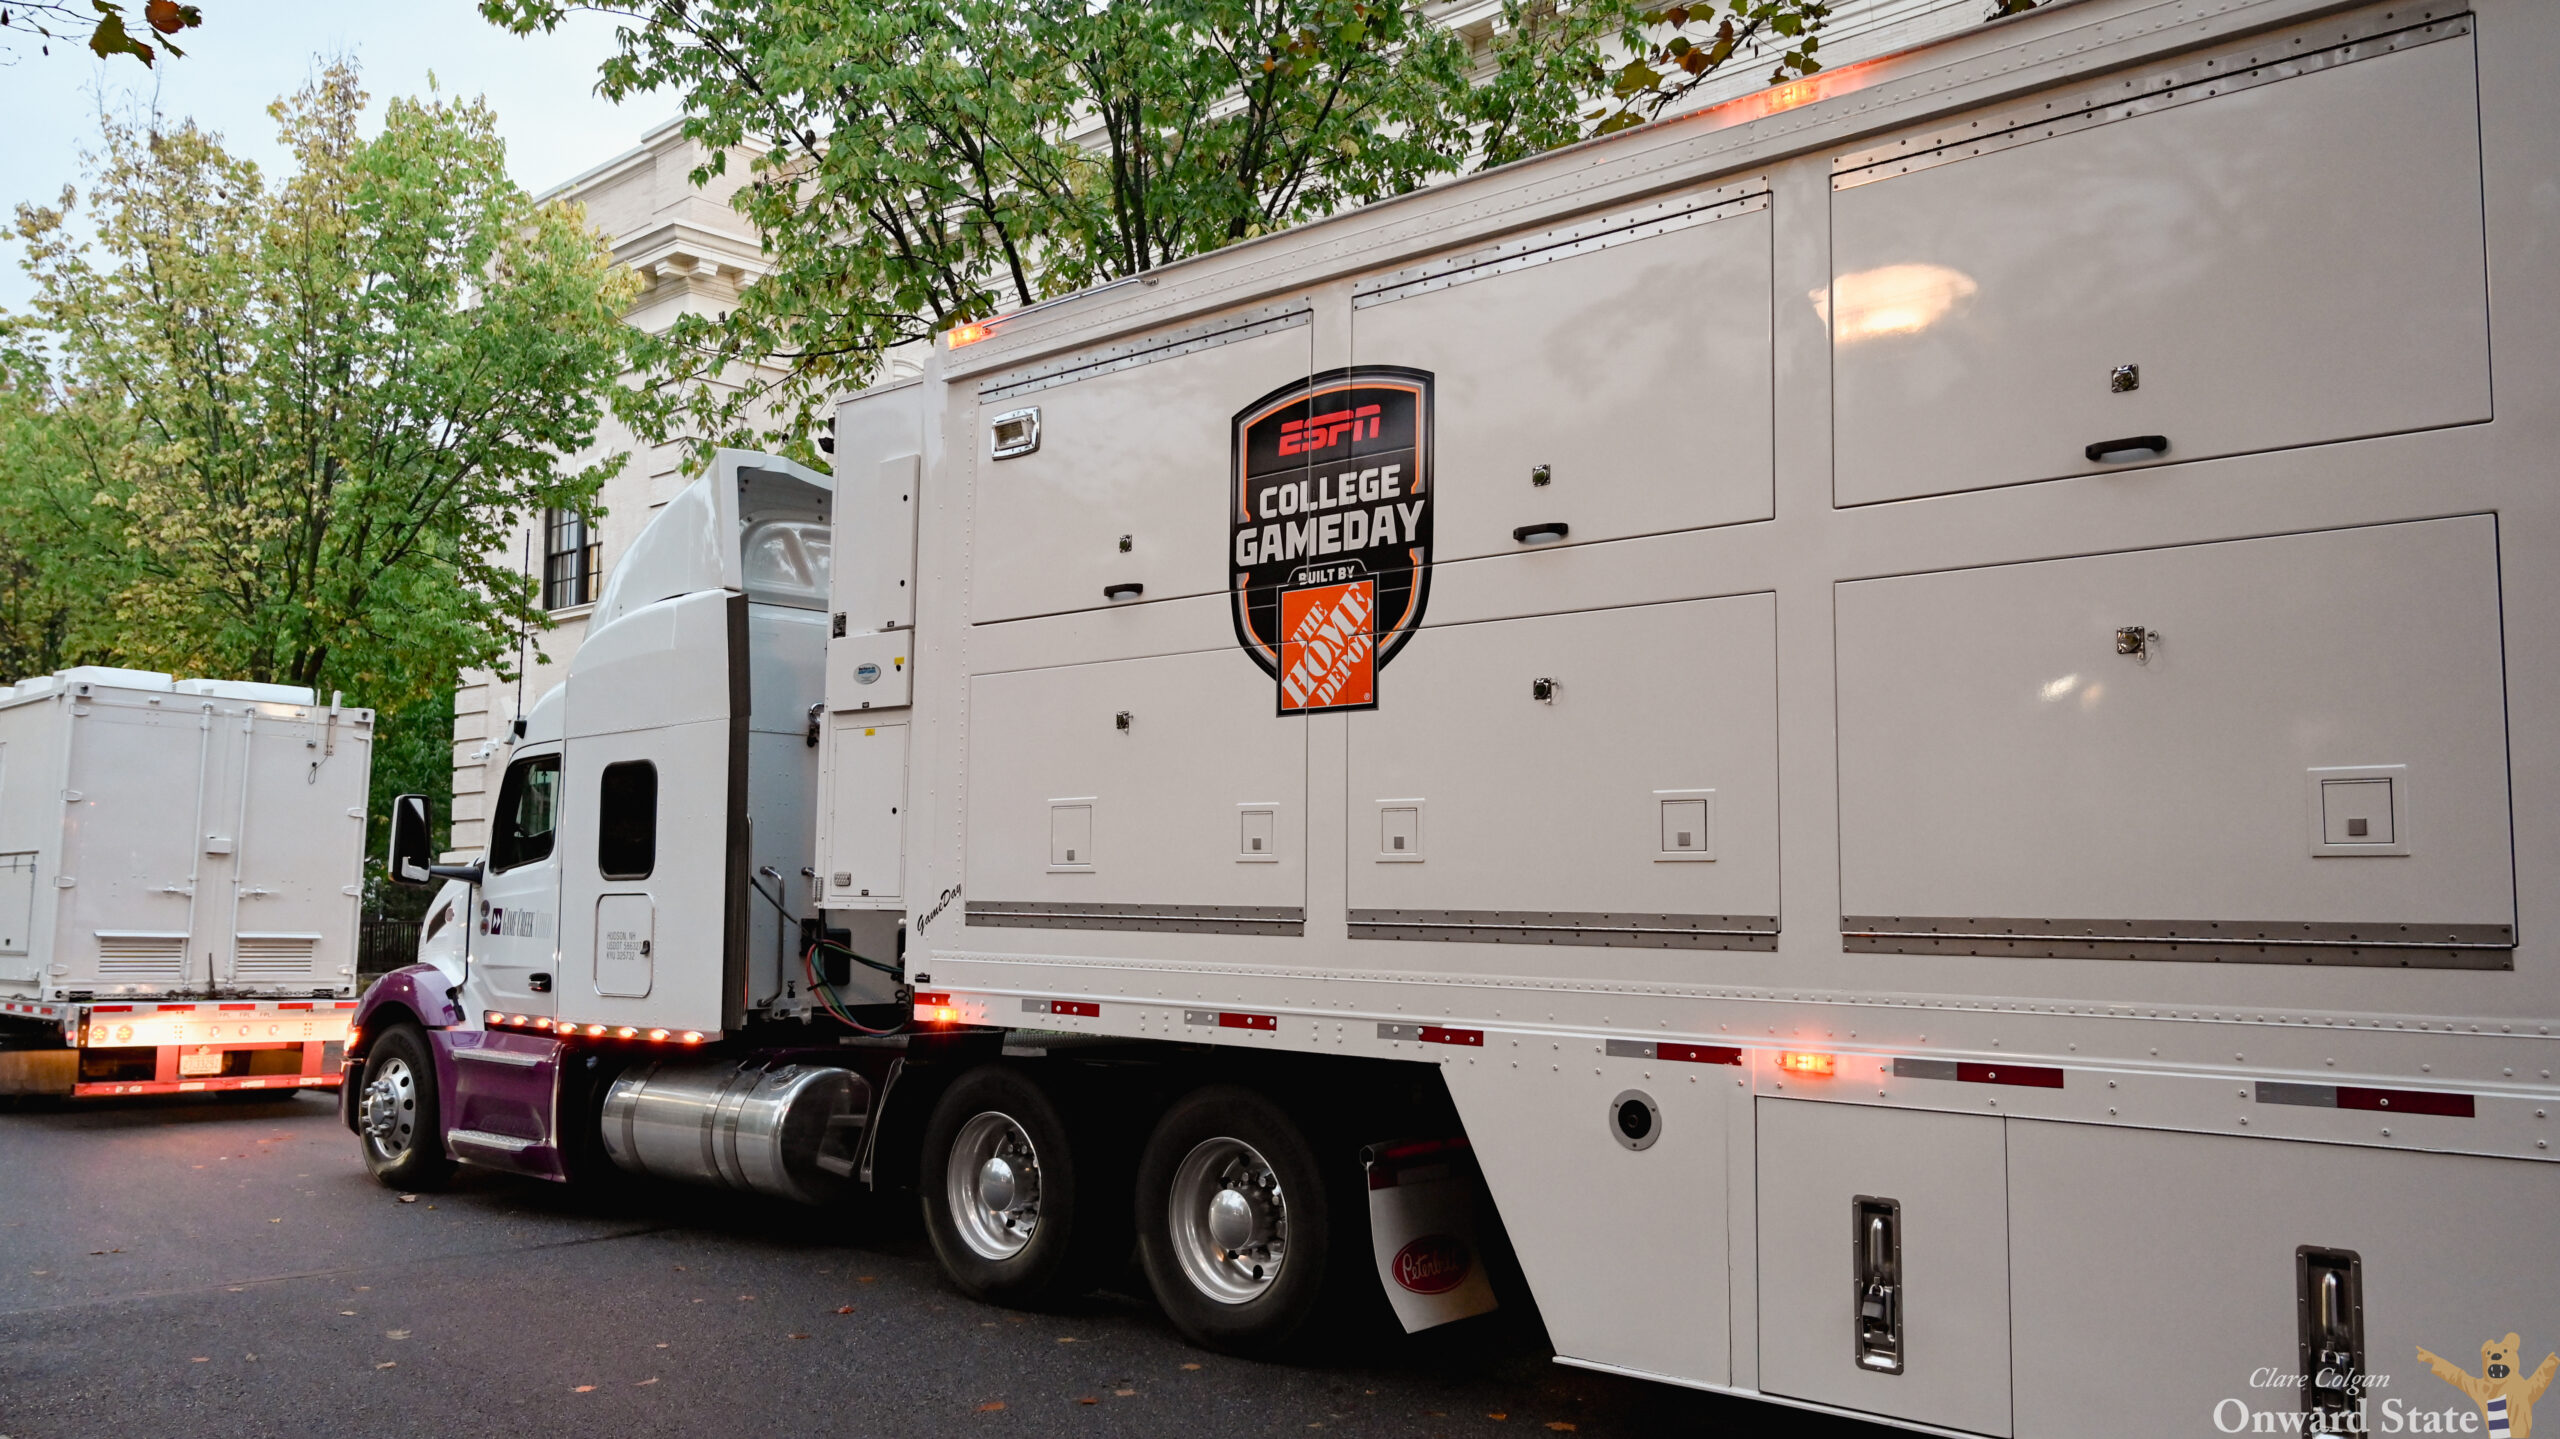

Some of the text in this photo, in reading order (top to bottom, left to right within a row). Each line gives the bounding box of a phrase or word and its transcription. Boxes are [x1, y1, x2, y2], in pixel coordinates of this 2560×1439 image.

[1278, 404, 1381, 457] ESPN
[1260, 464, 1401, 520] COLLEGE
[1236, 500, 1425, 567] GAMEDAY
[1298, 565, 1355, 585] BUILT BY
[1282, 583, 1373, 708] HOME
[1290, 600, 1328, 649] THE
[1316, 626, 1373, 706] DEPOT
[516, 908, 535, 938] CREEK
[917, 883, 962, 936] GameDay
[606, 941, 622, 950] USDOT
[1402, 1248, 1459, 1285] Peterbl
